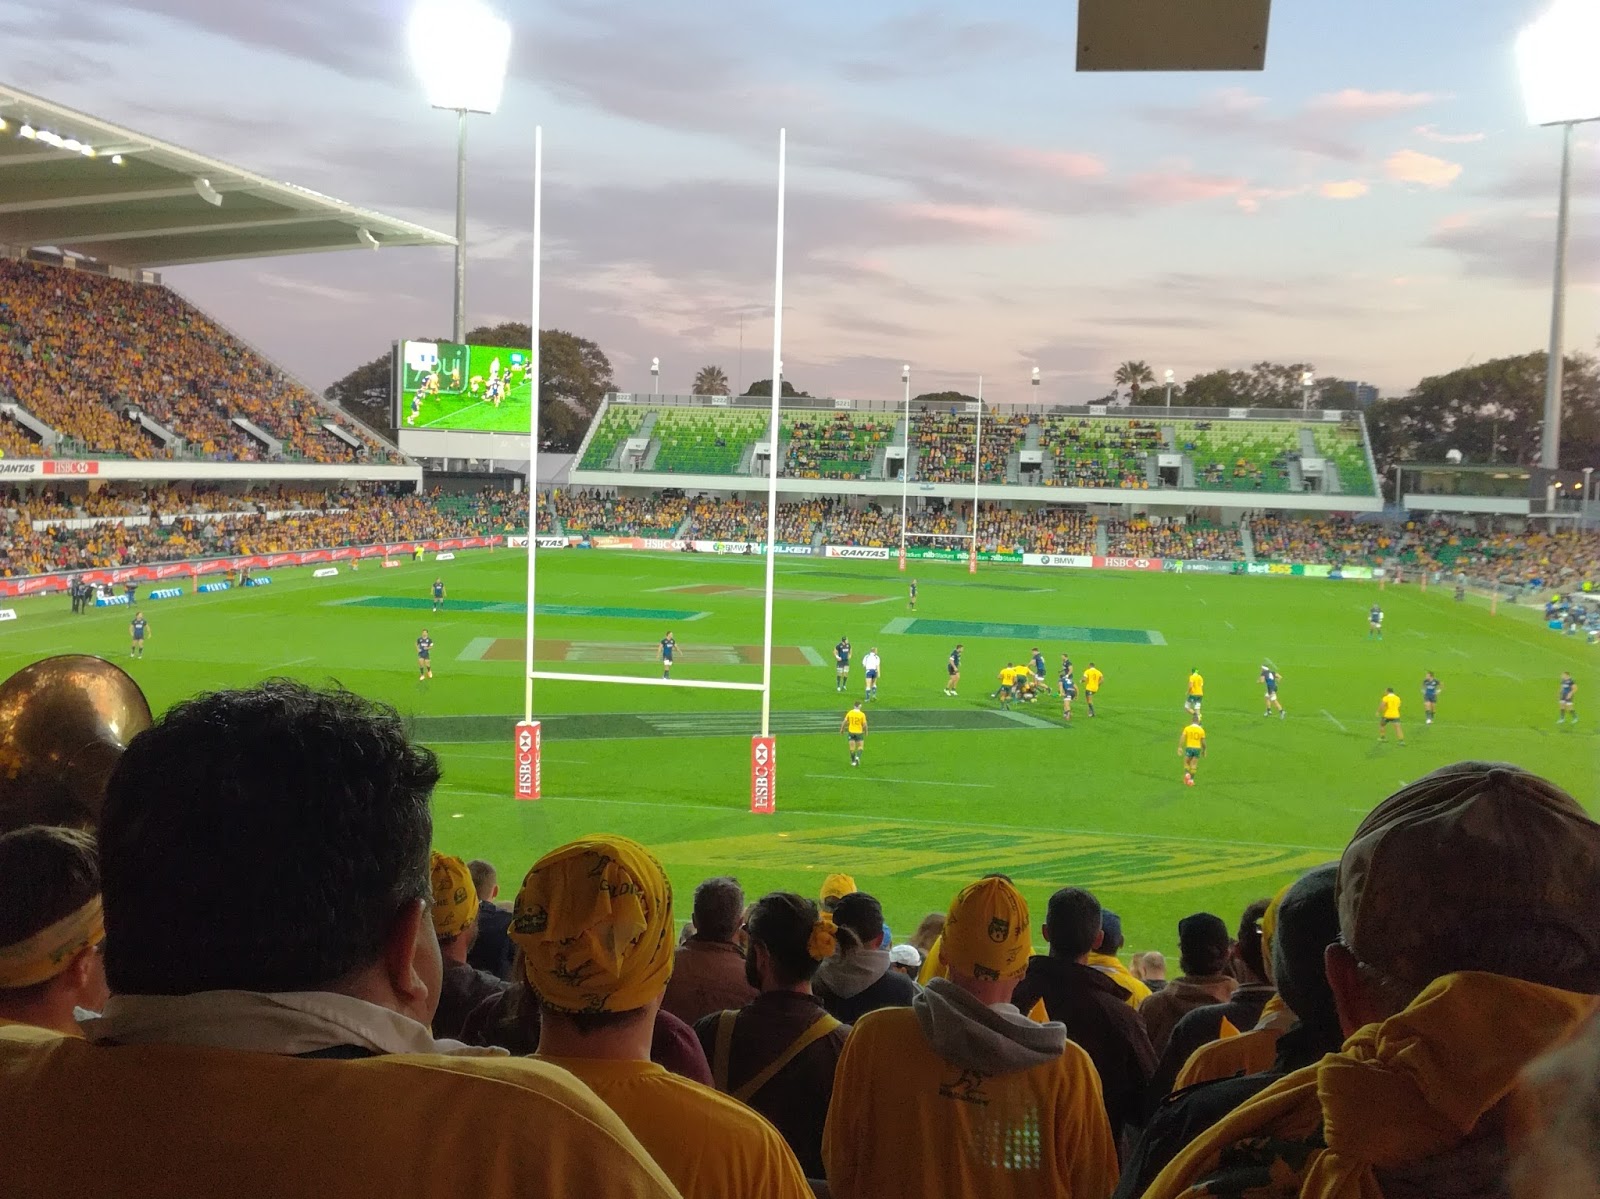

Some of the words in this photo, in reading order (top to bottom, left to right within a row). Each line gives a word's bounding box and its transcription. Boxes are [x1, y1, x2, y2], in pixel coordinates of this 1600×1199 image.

[54, 462, 77, 473] HSBC
[521, 539, 564, 547] QNTAS
[645, 539, 672, 549] HSBC
[725, 543, 746, 551] BMW
[841, 549, 887, 557] QANTAS
[1105, 558, 1134, 567] HSBC
[1248, 563, 1292, 574] bet365
[851, 717, 860, 726] 12
[1189, 732, 1200, 741] 10
[519, 753, 532, 795] HSBC
[755, 766, 768, 808] HSBC
